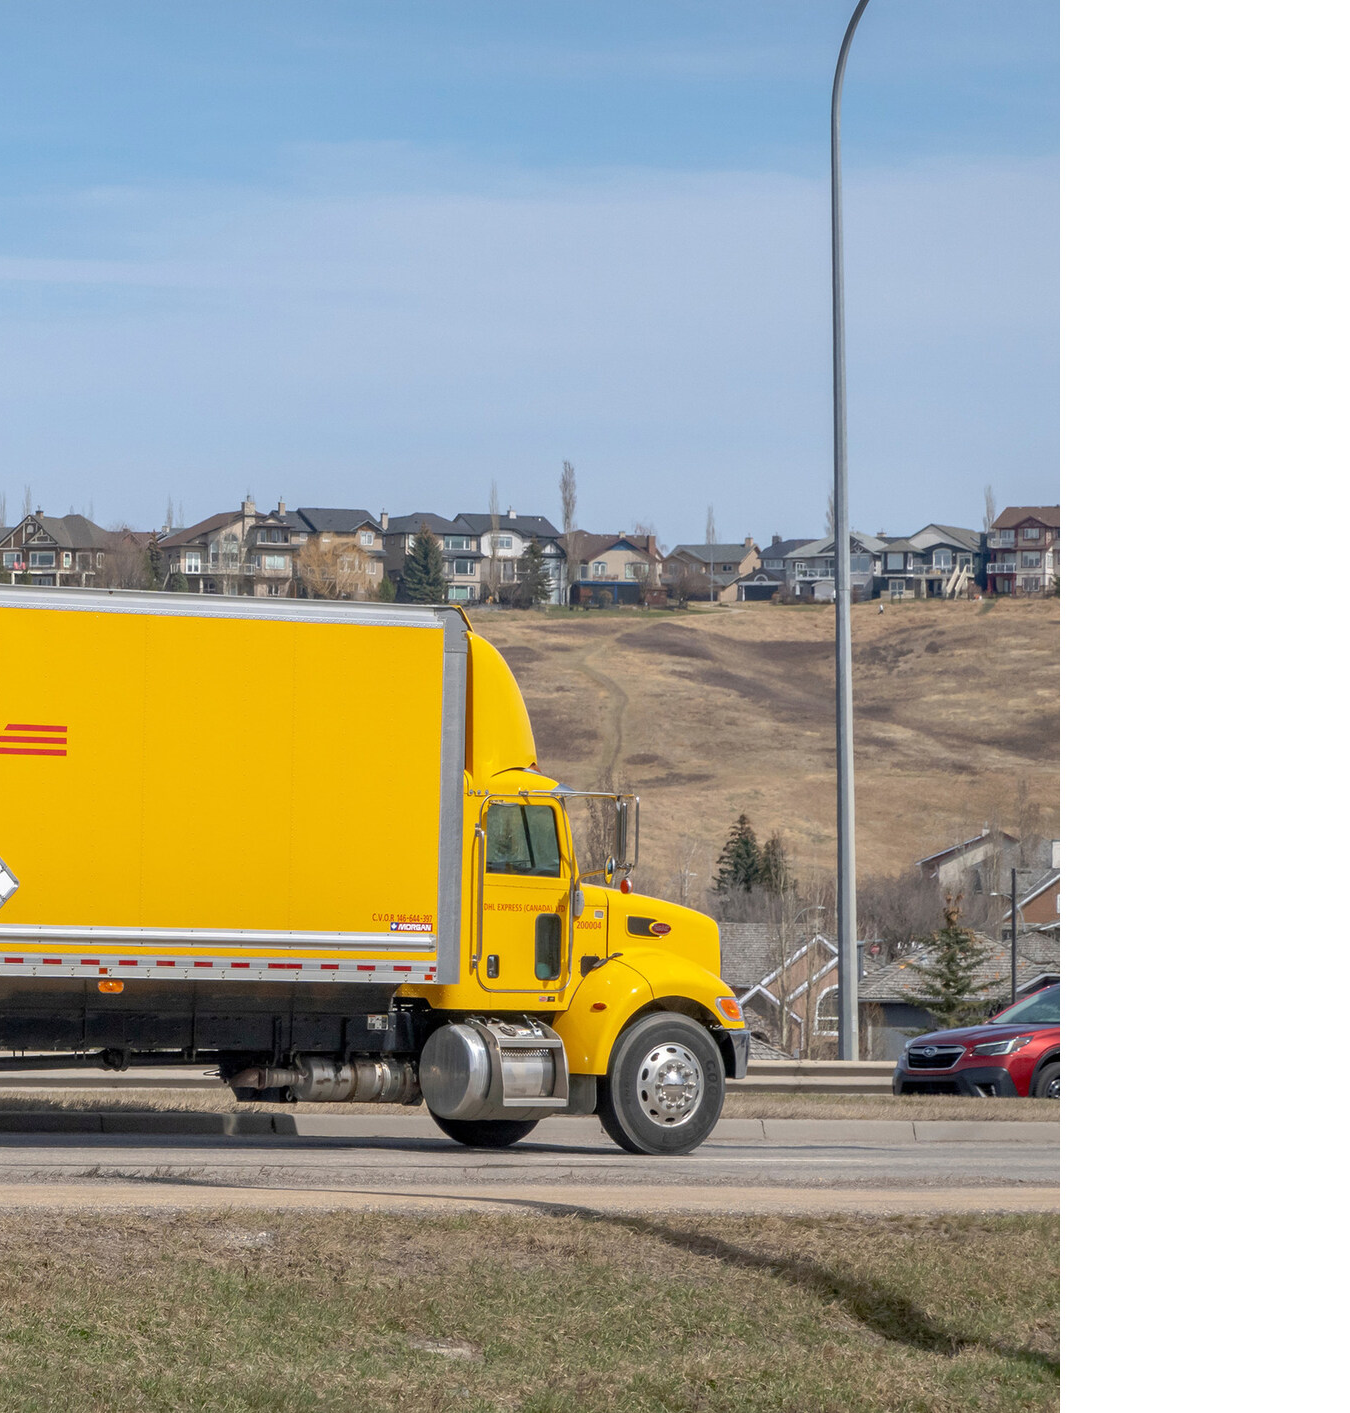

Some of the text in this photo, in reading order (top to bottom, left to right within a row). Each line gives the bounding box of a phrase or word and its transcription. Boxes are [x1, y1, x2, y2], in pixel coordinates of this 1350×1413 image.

[483, 903, 496, 911] DHL
[497, 903, 523, 912] EXPRESS
[396, 913, 433, 923] 146-644-397
[398, 923, 432, 932] MORGAN
[576, 921, 602, 930] 200004
